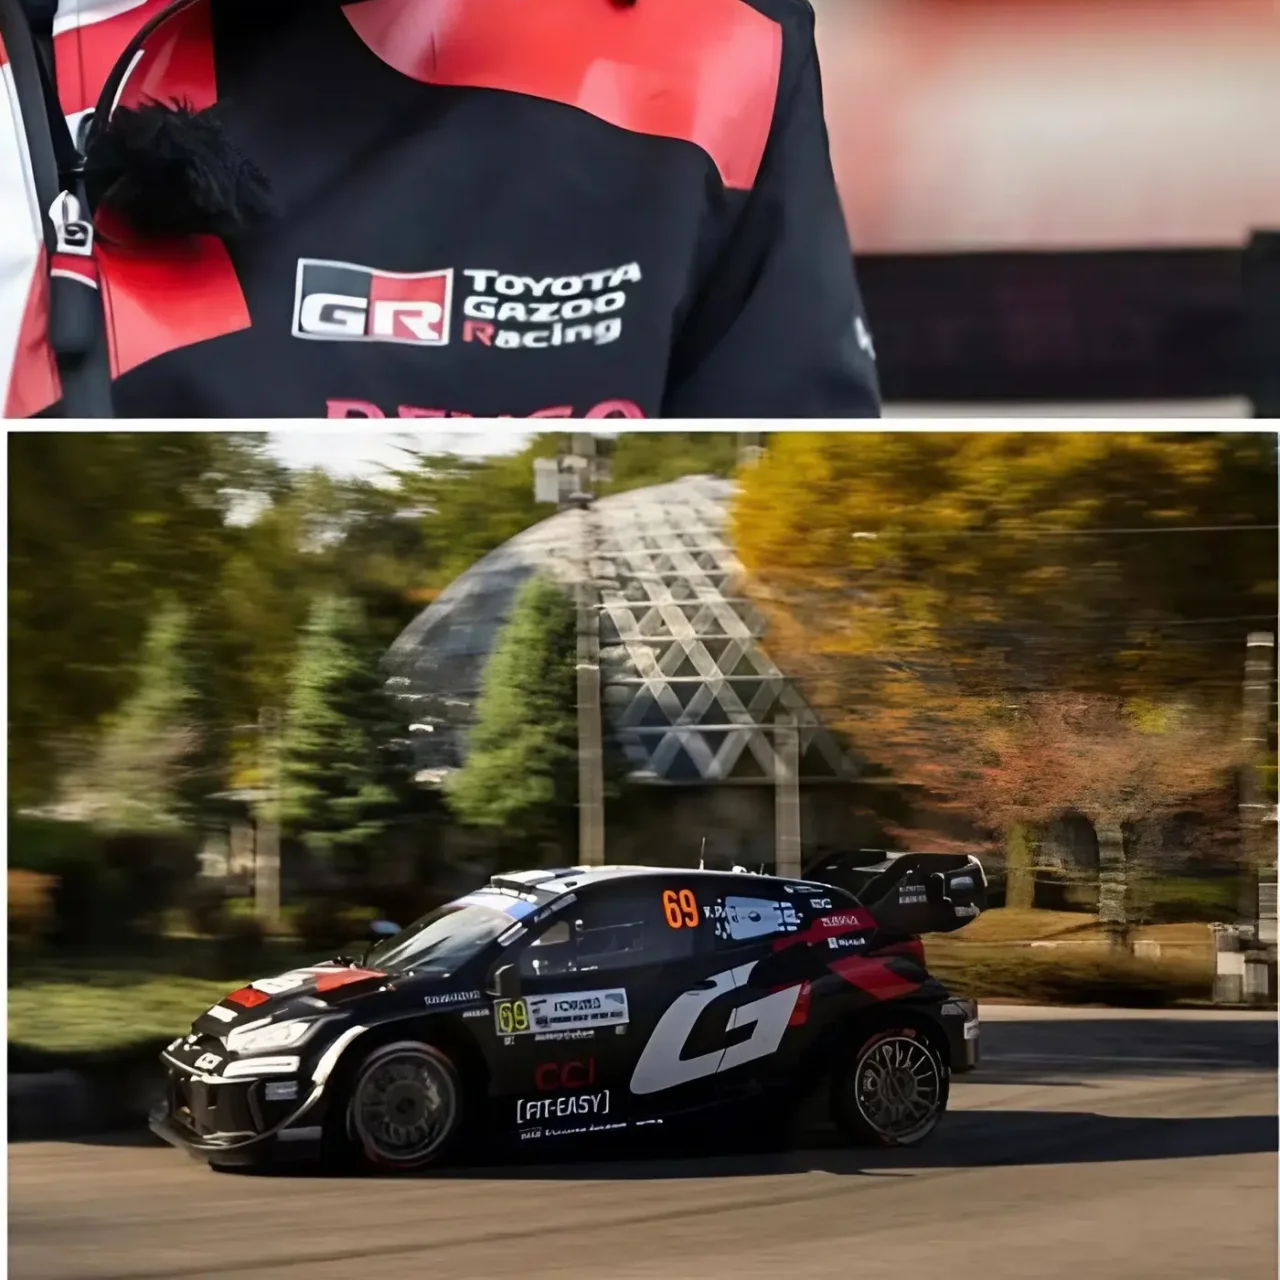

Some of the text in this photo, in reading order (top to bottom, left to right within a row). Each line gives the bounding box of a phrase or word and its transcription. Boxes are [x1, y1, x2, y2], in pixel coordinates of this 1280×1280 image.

[462, 261, 643, 297] TOYOTA
[300, 293, 443, 341] GR
[463, 291, 626, 323] GAZOO
[462, 318, 623, 349] Racing
[663, 889, 699, 929] 69
[498, 1001, 529, 1033] 69
[534, 1057, 596, 1091] CCI
